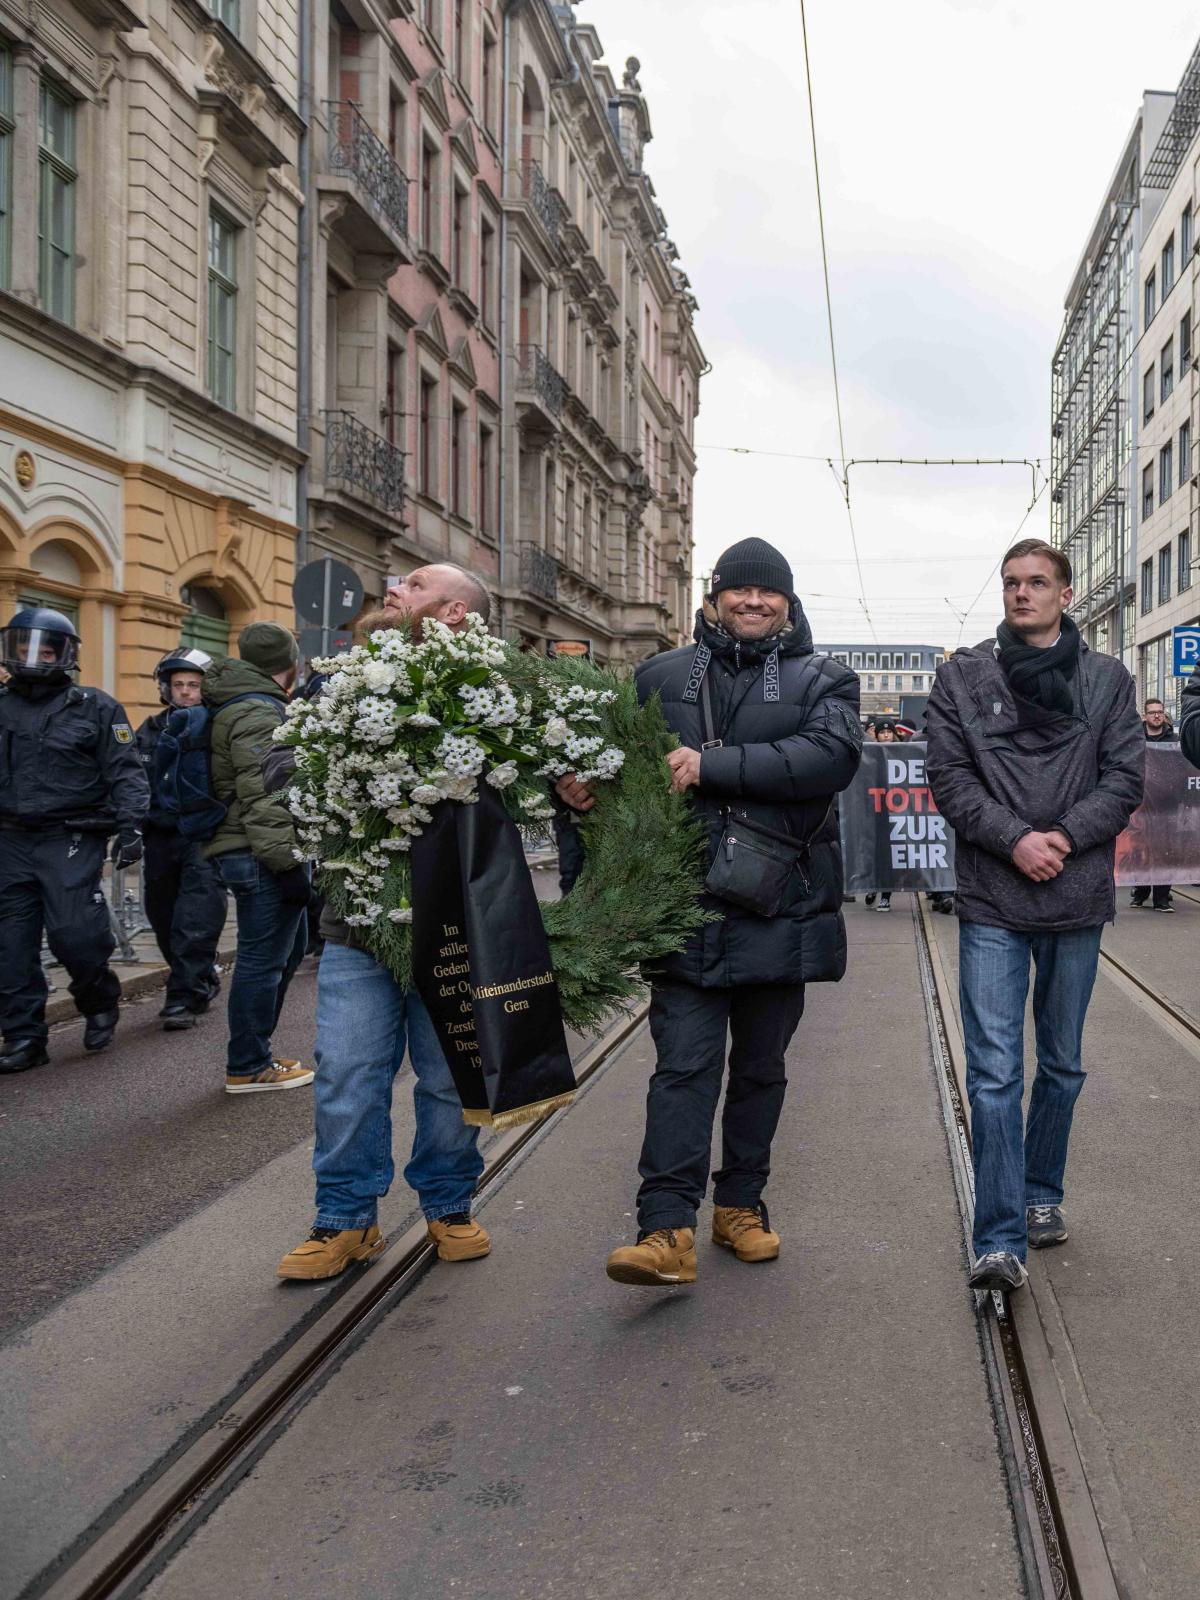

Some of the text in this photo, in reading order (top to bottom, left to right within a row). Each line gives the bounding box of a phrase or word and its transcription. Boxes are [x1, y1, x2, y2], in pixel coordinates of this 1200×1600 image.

[1181, 638, 1198, 660] P
[887, 759, 930, 784] DE
[888, 815, 948, 841] ZUR
[891, 844, 949, 870] EHR
[443, 925, 459, 936] Im
[439, 943, 469, 957] stiller
[439, 984, 456, 997] der
[472, 972, 554, 1000] Miteinanderstadt
[504, 1000, 530, 1013] Gera
[470, 1056, 482, 1068] 19
